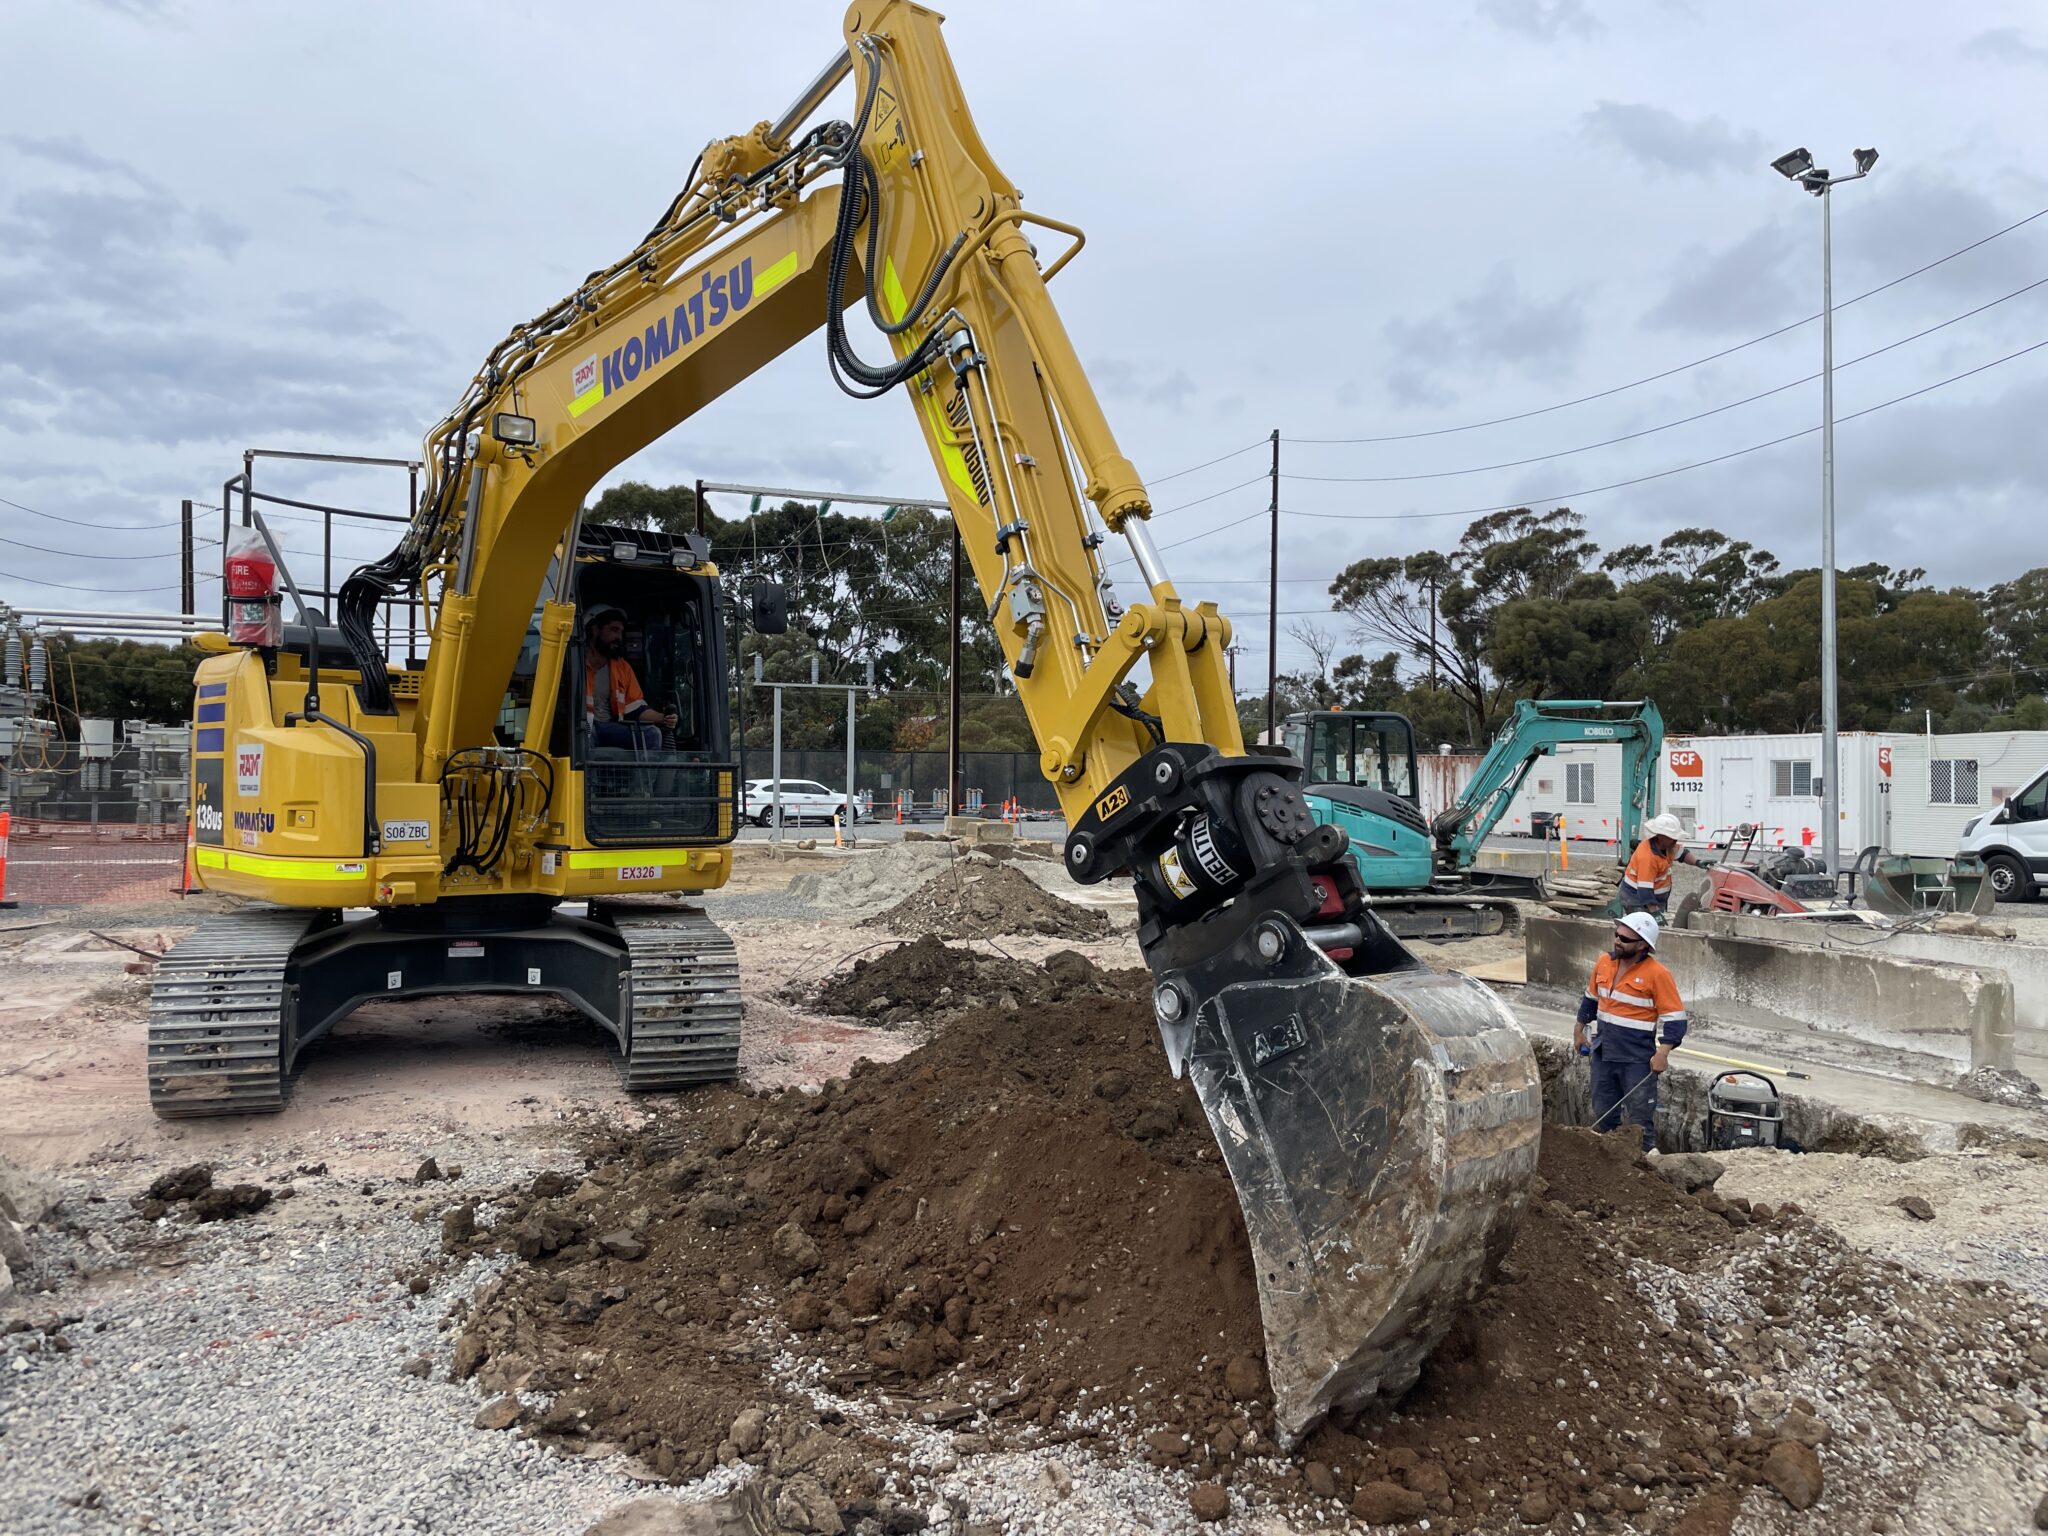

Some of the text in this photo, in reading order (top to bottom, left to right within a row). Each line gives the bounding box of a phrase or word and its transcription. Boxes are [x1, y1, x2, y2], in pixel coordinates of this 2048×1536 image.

[602, 256, 753, 398] KOMATSU
[575, 361, 595, 386] RAM
[232, 565, 249, 575] FIRE
[1584, 727, 1614, 736] KOBELCO
[240, 754, 260, 776] RAM
[1671, 753, 1696, 766] SCF
[197, 783, 207, 800] PC
[234, 807, 275, 833] KOMATSU
[408, 826, 427, 838] ZBC
[621, 866, 655, 880] EX326
